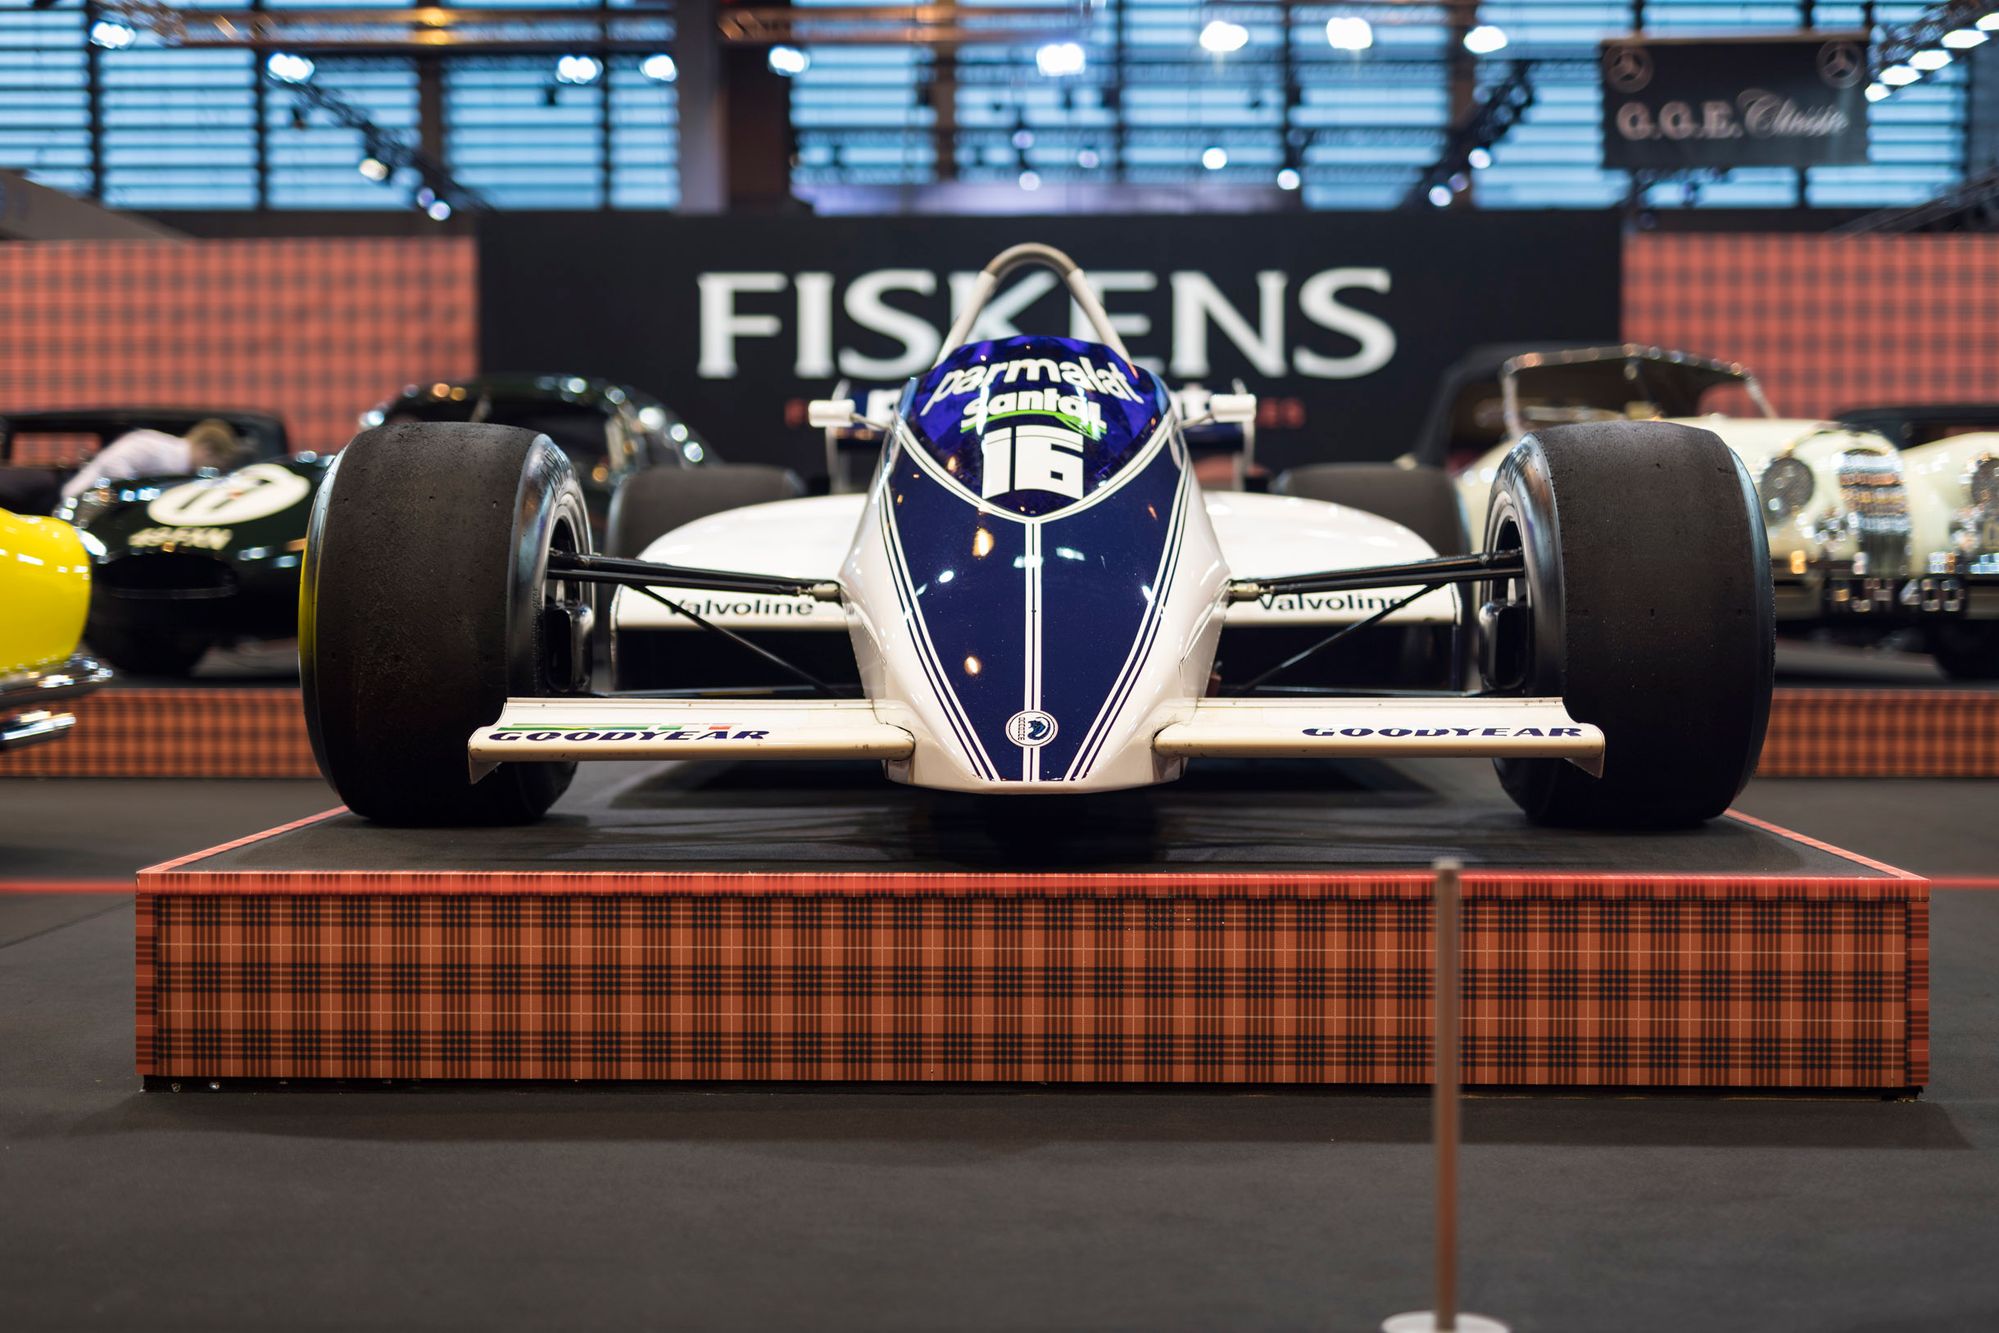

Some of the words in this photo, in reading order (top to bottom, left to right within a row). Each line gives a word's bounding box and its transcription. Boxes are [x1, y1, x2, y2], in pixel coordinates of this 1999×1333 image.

[697, 268, 1398, 380] FISKENS
[920, 356, 1145, 417] parmalat
[981, 424, 1084, 501] 16
[488, 730, 770, 742] GOODYEAR
[1301, 727, 1583, 738] GOODYEAR
